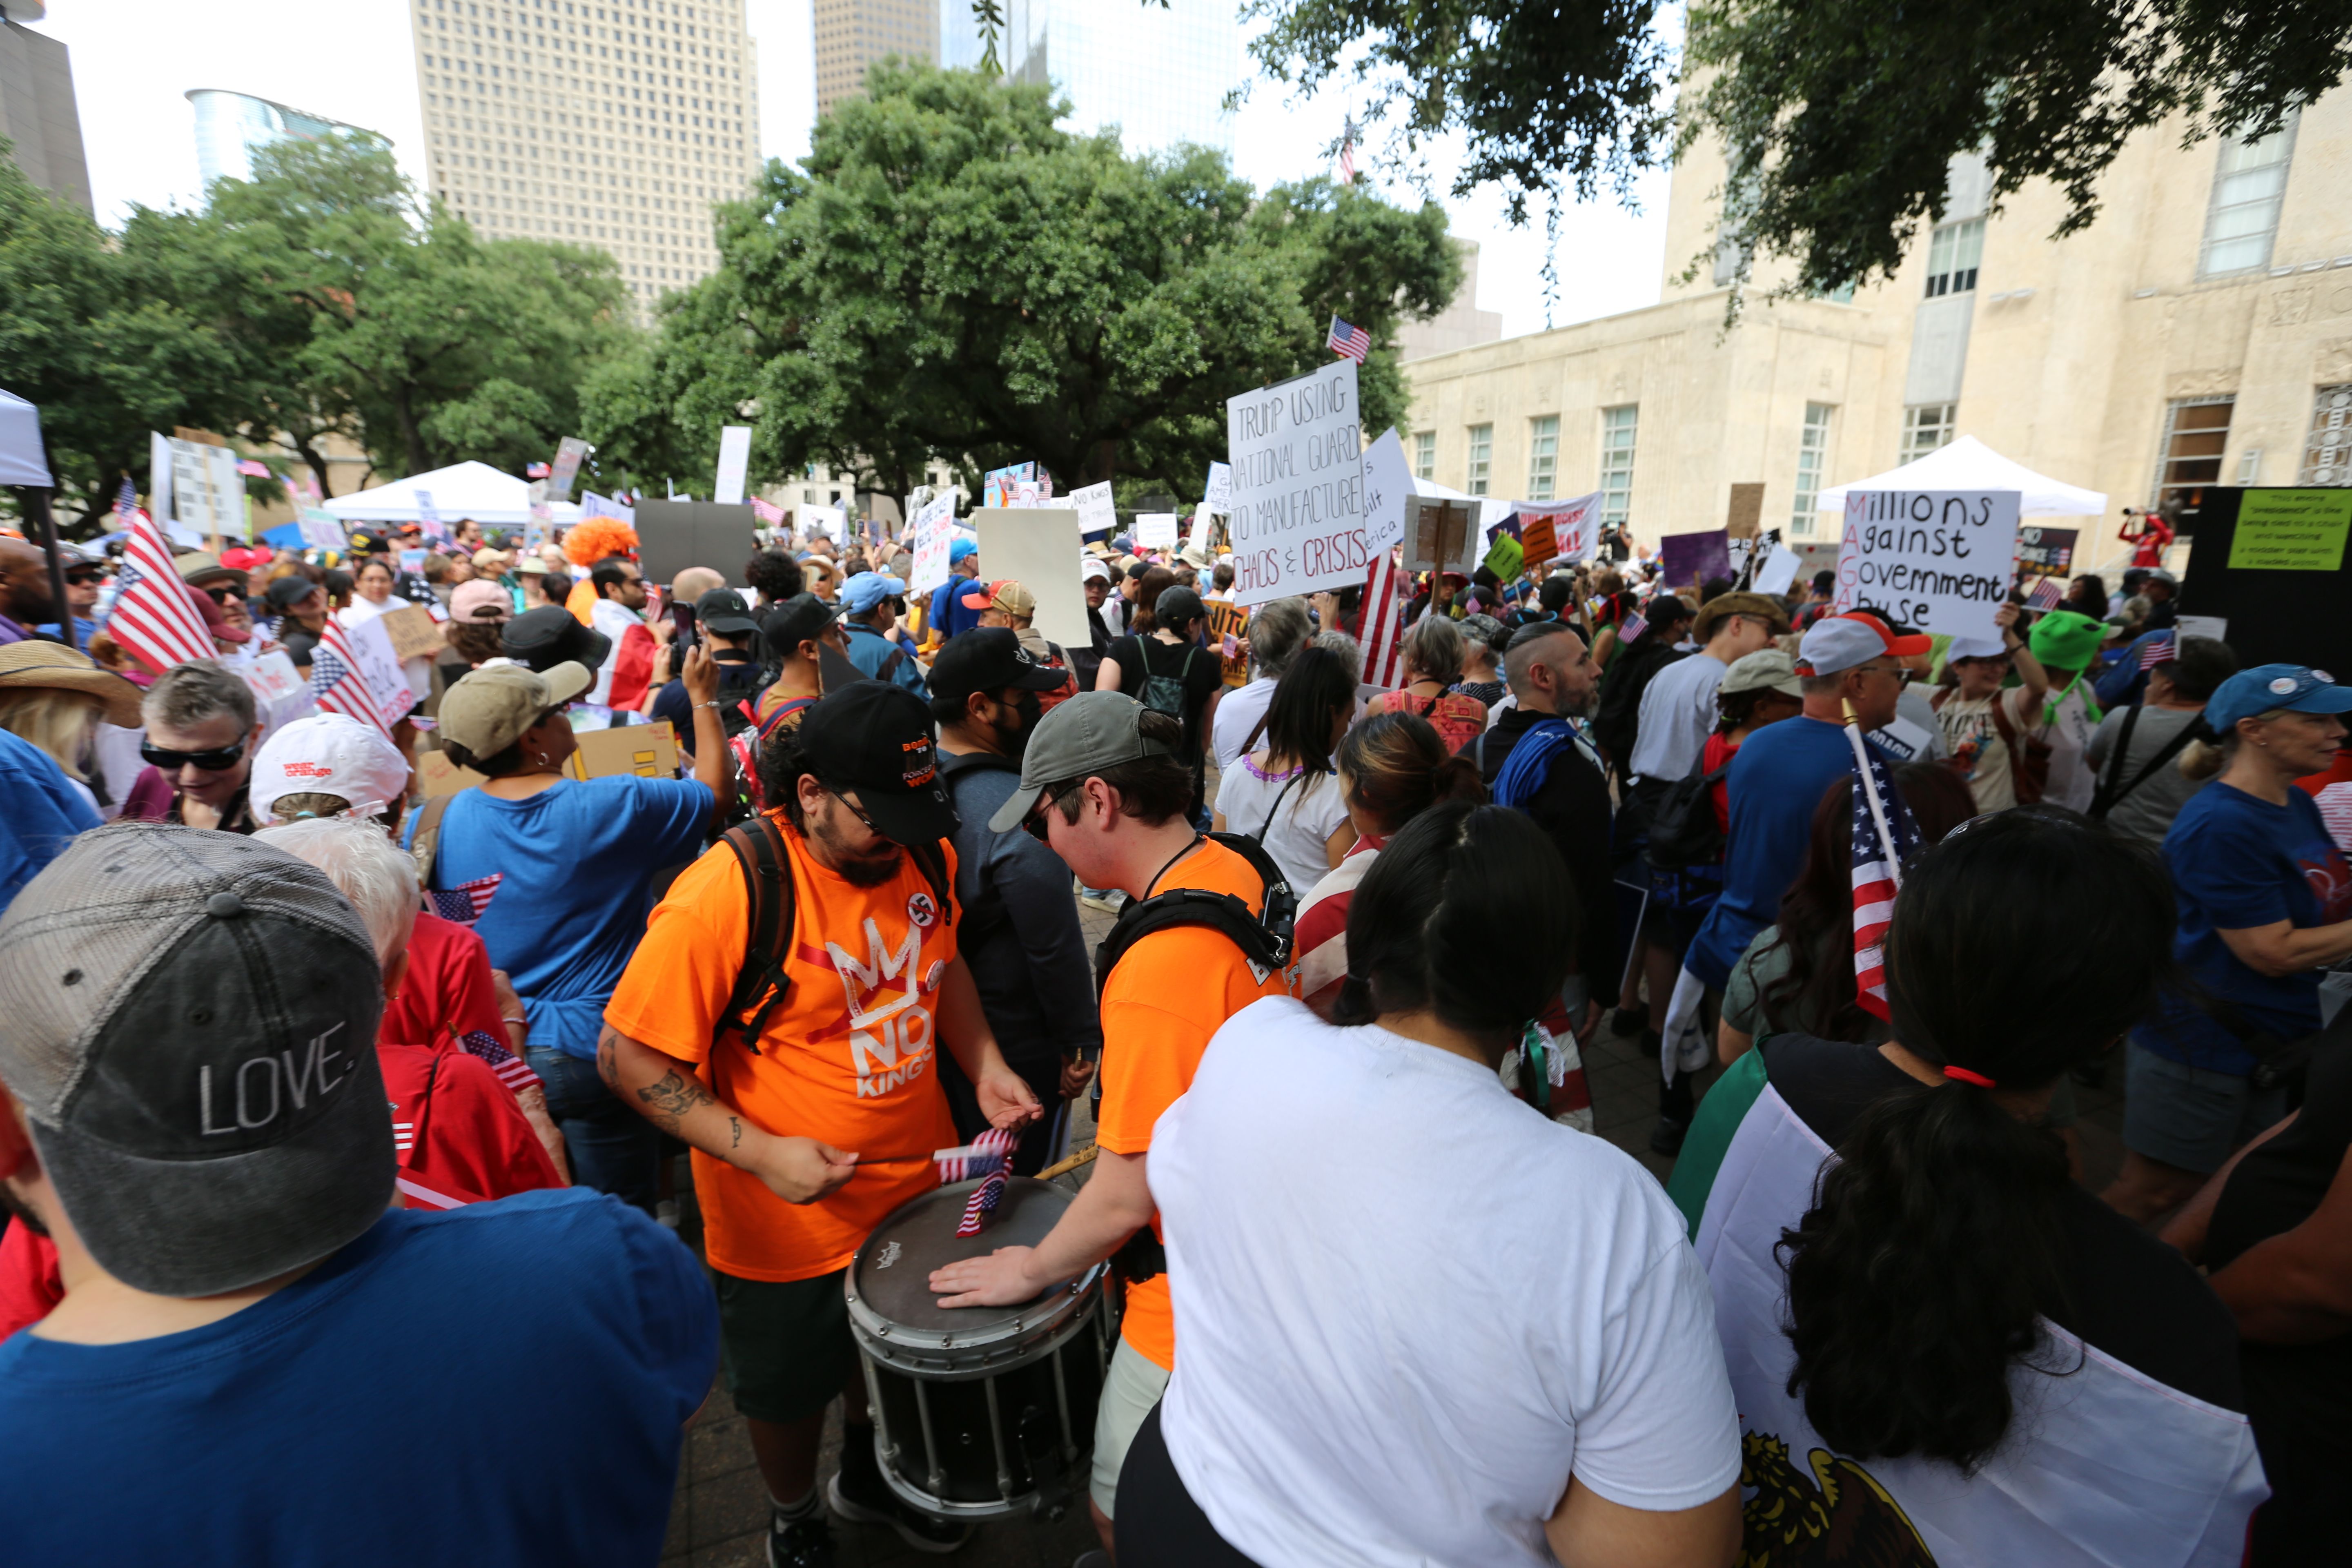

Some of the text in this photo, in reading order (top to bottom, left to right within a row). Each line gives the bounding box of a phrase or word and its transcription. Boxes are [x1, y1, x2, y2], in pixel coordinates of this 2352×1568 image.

[1237, 376, 1346, 441] TRUMP USING
[1230, 443, 1300, 491] NATIONAL
[1309, 425, 1359, 471] GUARD
[1073, 494, 1087, 506] NO
[1231, 505, 1249, 540] TO
[1256, 475, 1361, 536] MANUFACTURE
[1845, 492, 1993, 526] Millions
[1234, 529, 1366, 592] CHAOS & CRISIS
[1840, 524, 1971, 558] Against
[2023, 528, 2042, 545] NO
[1838, 556, 2007, 602] Government
[902, 737, 928, 752] BORN
[286, 768, 332, 777] orange
[849, 1004, 931, 1077] NO
[200, 1020, 346, 1136] LOVE
[856, 1044, 932, 1098] KINGS
